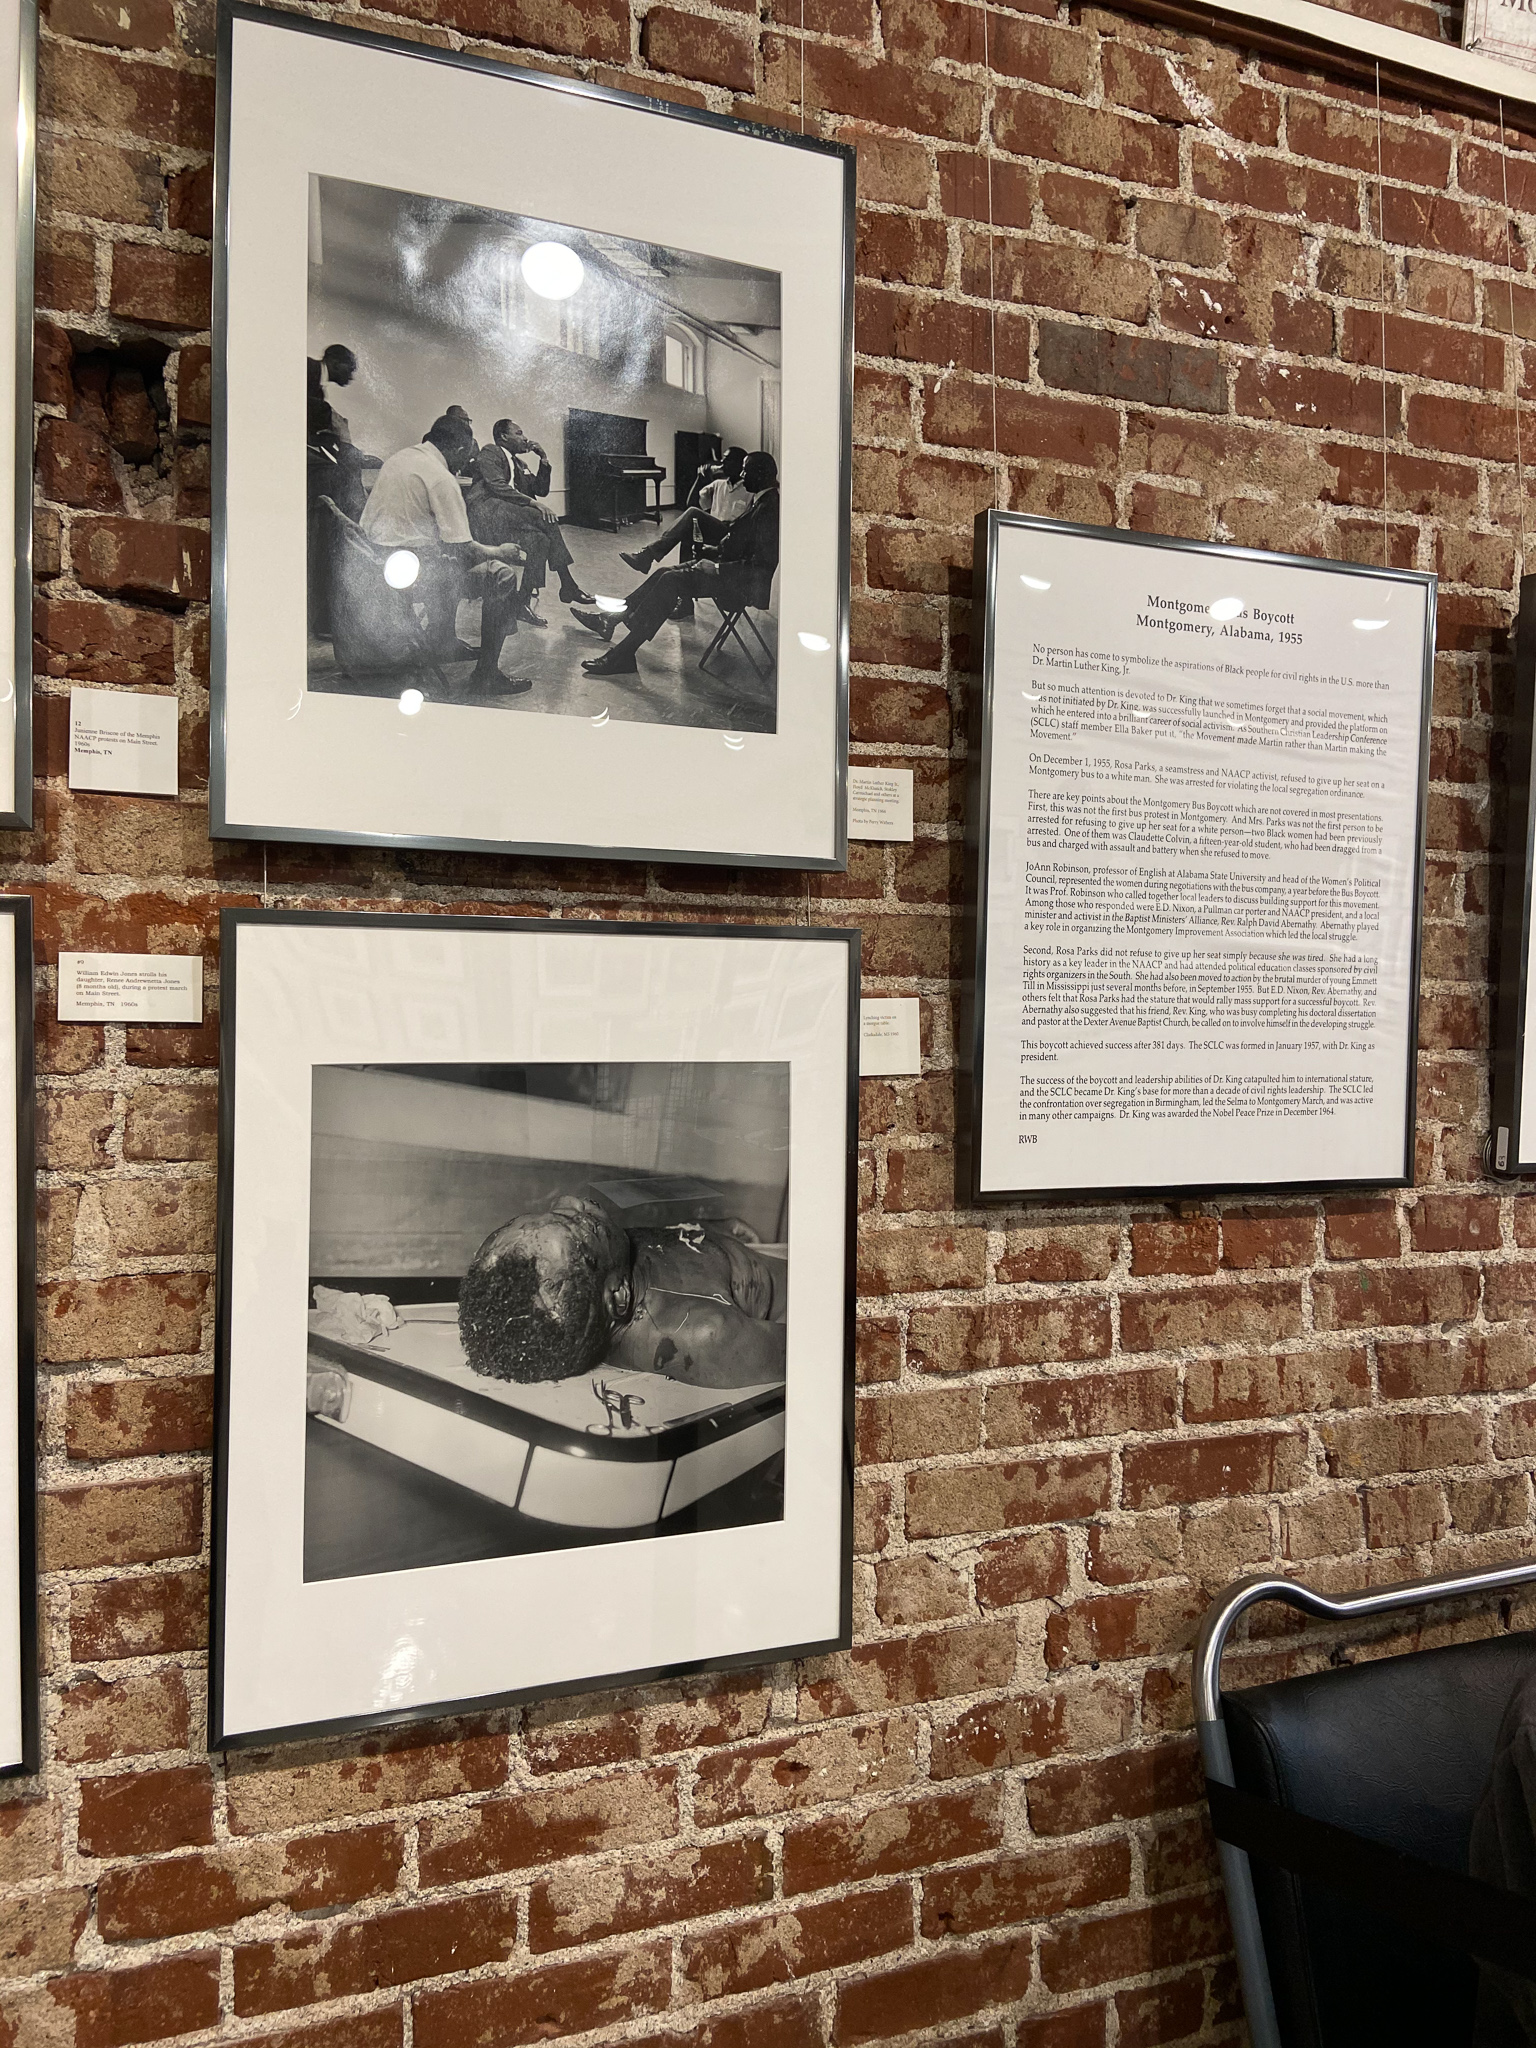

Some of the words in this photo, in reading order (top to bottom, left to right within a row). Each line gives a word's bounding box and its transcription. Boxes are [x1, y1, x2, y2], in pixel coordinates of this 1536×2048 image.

[1147, 595, 1214, 616] Montgome
[1253, 608, 1295, 625] Boycott
[1136, 613, 1214, 637] Montgomery,
[1220, 623, 1273, 642] Alabama,
[1278, 629, 1302, 644] 1955
[1032, 656, 1045, 666] Dr.
[1045, 657, 1072, 668] Martin
[1073, 660, 1100, 671] Luther
[1101, 663, 1121, 676] King,
[1032, 645, 1045, 654] No
[1046, 648, 1073, 659] person
[1075, 649, 1089, 659] has
[1089, 653, 1110, 661] come
[1111, 654, 1120, 662] to
[1120, 654, 1159, 668] symbolize
[1161, 658, 1173, 667] the
[1174, 660, 1214, 674] aspirations
[1215, 664, 1223, 673] of
[1224, 665, 1244, 675] Black
[1245, 667, 1269, 680] people
[1270, 670, 1281, 679] for
[1282, 671, 1297, 680] civil
[1298, 673, 1318, 685] rights
[1320, 675, 1327, 683] in
[1328, 676, 1339, 685] the
[1340, 677, 1354, 686] U.S.
[1374, 681, 1389, 690] than
[1028, 790, 1051, 799] There
[1065, 792, 1080, 804] key
[1081, 793, 1105, 805] points
[1106, 795, 1128, 805] about
[1129, 797, 1142, 806] the
[1142, 798, 1190, 811] Montgomery
[1191, 801, 1205, 810] Bus
[1206, 802, 1233, 814] Boycott
[1234, 804, 1256, 813] which
[1269, 807, 1281, 815] not
[1282, 807, 1309, 817] covered
[1310, 809, 1318, 818] in
[1318, 811, 1335, 819] most
[1336, 811, 1381, 824] presentations.
[1026, 861, 1051, 873] JoAnn
[1052, 863, 1091, 874] Robinson,
[1092, 865, 1128, 877] professor
[1129, 867, 1138, 875] of
[1138, 867, 1166, 879] English
[1176, 869, 1209, 879] Alabama
[1210, 871, 1228, 880] State
[1229, 872, 1266, 884] University
[1267, 874, 1281, 882] and
[1282, 875, 1299, 883] head
[1300, 876, 1307, 884] of
[1309, 876, 1320, 884] the
[1321, 877, 1352, 886] Women's
[1353, 878, 1381, 887] Political
[1020, 1040, 1038, 1049] This
[1039, 1040, 1068, 1051] boycott
[1069, 1041, 1103, 1049] achieved
[1133, 1041, 1151, 1049] after
[1152, 1041, 1164, 1049] 381
[1166, 1041, 1185, 1052] days.
[1189, 1042, 1202, 1050] The
[1203, 1042, 1224, 1050] SCLC
[1240, 1042, 1266, 1050] formed
[1267, 1042, 1274, 1050] in
[1275, 1042, 1302, 1052] January
[1304, 1043, 1320, 1051] 1957,
[1350, 1043, 1366, 1053] King
[1020, 1052, 1058, 1062] president.
[1019, 1076, 1035, 1084] The
[1066, 1076, 1074, 1084] of
[1075, 1076, 1088, 1084] the
[1088, 1076, 1117, 1086] boycott
[1118, 1076, 1133, 1084] and
[1134, 1076, 1173, 1086] leadership
[1174, 1076, 1203, 1084] abilities
[1204, 1076, 1211, 1084] of
[1212, 1076, 1224, 1084] Dr.
[1225, 1076, 1242, 1086] King
[1243, 1076, 1280, 1086] catapulted
[1018, 1135, 1038, 1143] RWB
